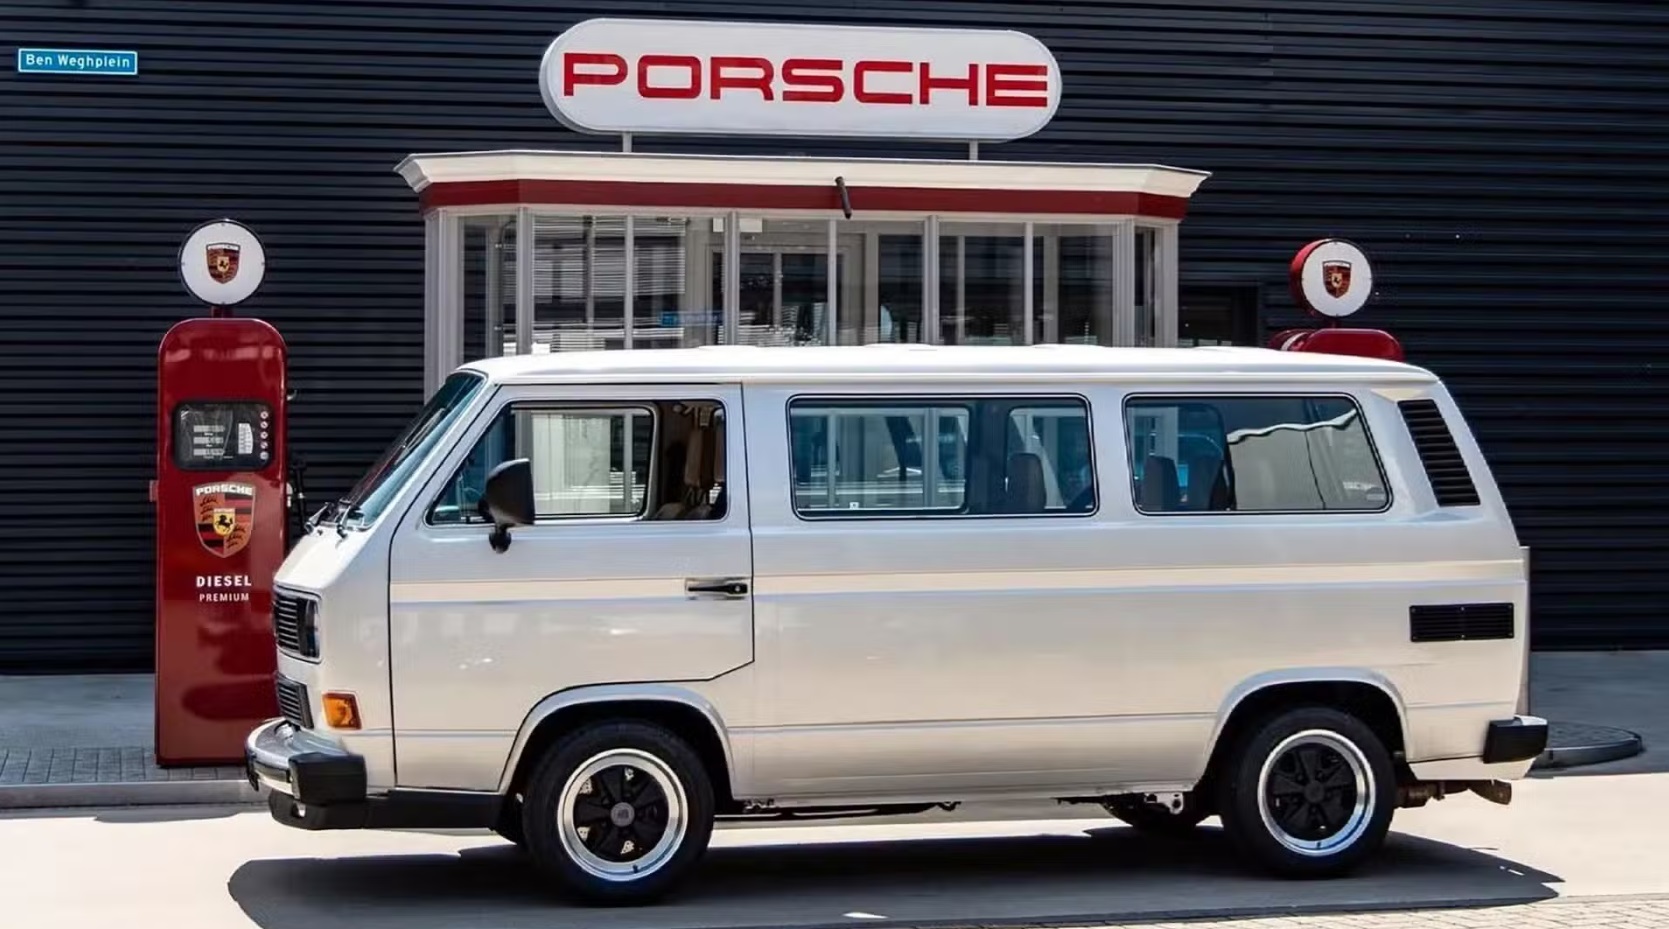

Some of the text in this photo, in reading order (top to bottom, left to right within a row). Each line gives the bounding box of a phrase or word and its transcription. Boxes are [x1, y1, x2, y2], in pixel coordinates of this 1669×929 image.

[26, 54, 130, 69] Ben Weghplein
[563, 53, 1048, 107] PORSCHE
[195, 484, 253, 496] PORSCHE
[196, 575, 252, 587] DIESEL
[199, 593, 249, 602] PREMIUM
